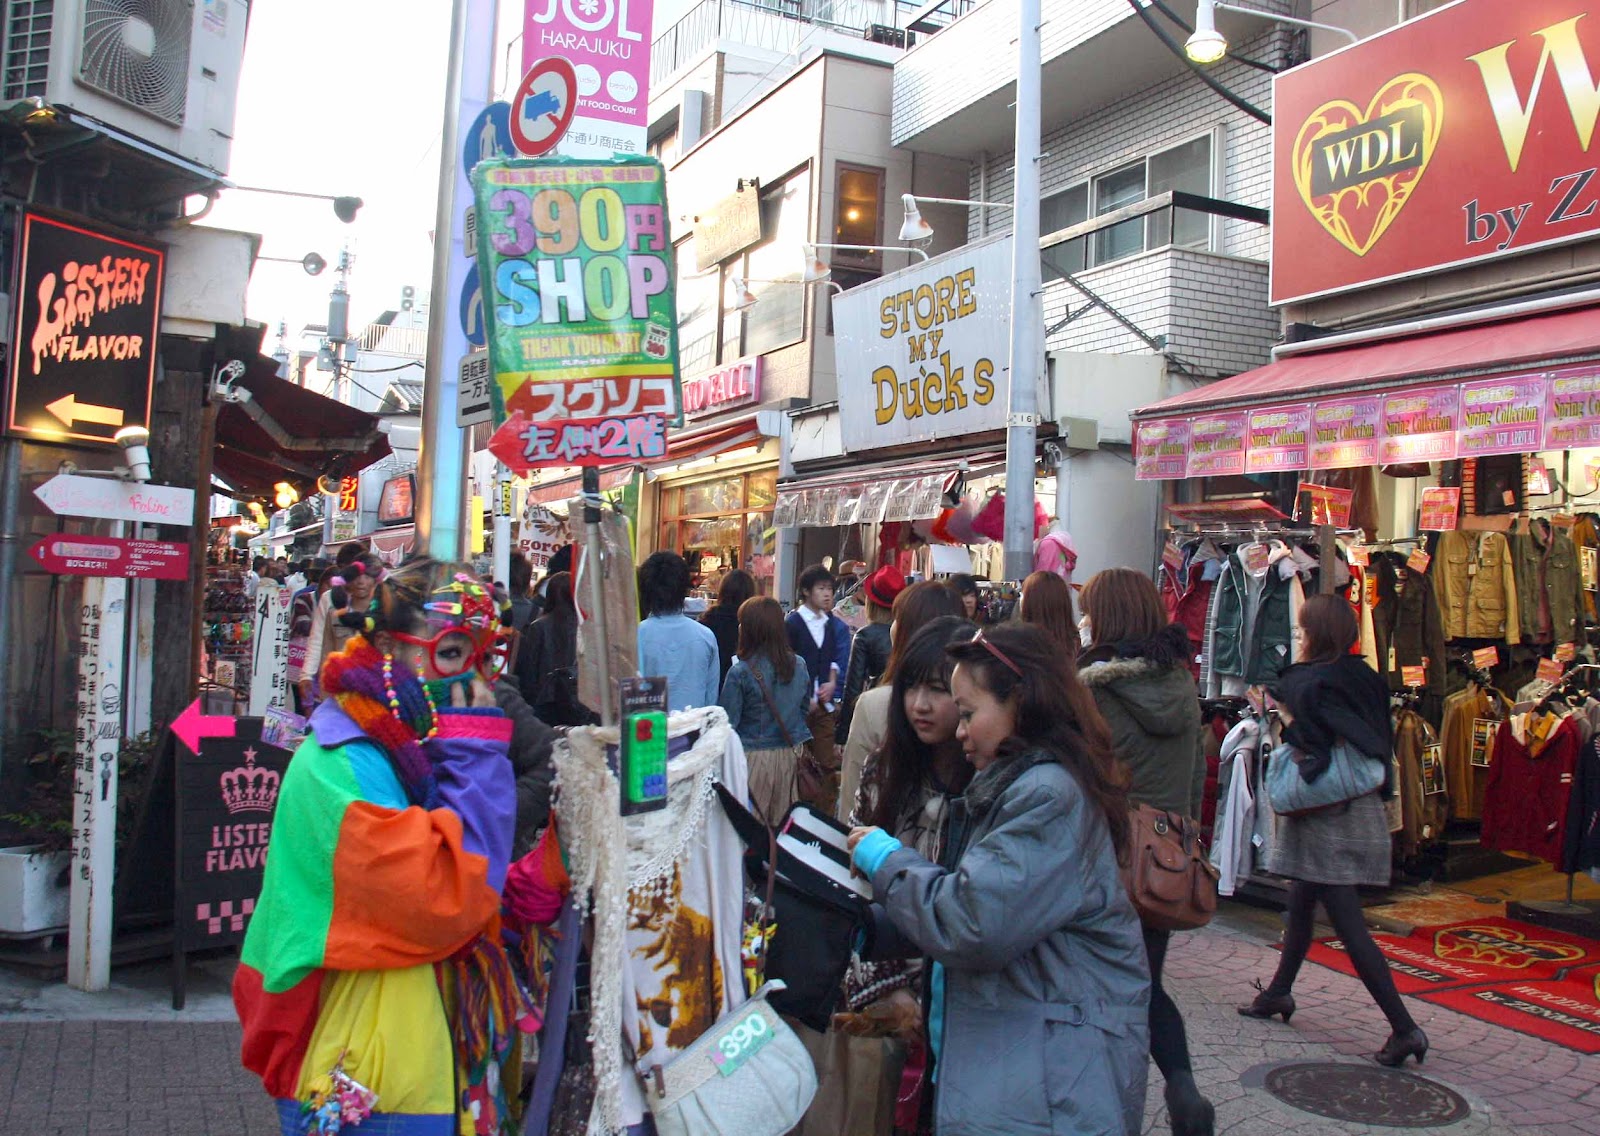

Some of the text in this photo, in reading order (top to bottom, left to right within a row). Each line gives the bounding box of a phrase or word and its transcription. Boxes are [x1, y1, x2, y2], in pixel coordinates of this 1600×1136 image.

[541, 29, 631, 59] HARAJUKU
[588, 101, 611, 110] FOOD
[612, 104, 637, 115] COURT
[1323, 120, 1418, 183] WDL
[490, 187, 665, 256] 390円
[1461, 199, 1532, 250] by
[495, 255, 670, 327] SHOP
[879, 267, 977, 339] STORE
[56, 335, 143, 363] FLAVOR
[908, 328, 944, 364] MY
[531, 377, 677, 421] スグソコ
[1465, 405, 1492, 429] Spring
[1494, 402, 1537, 425] Collection
[1412, 411, 1451, 433] Collection
[212, 823, 270, 848] LISTE
[718, 1013, 767, 1059] 390
